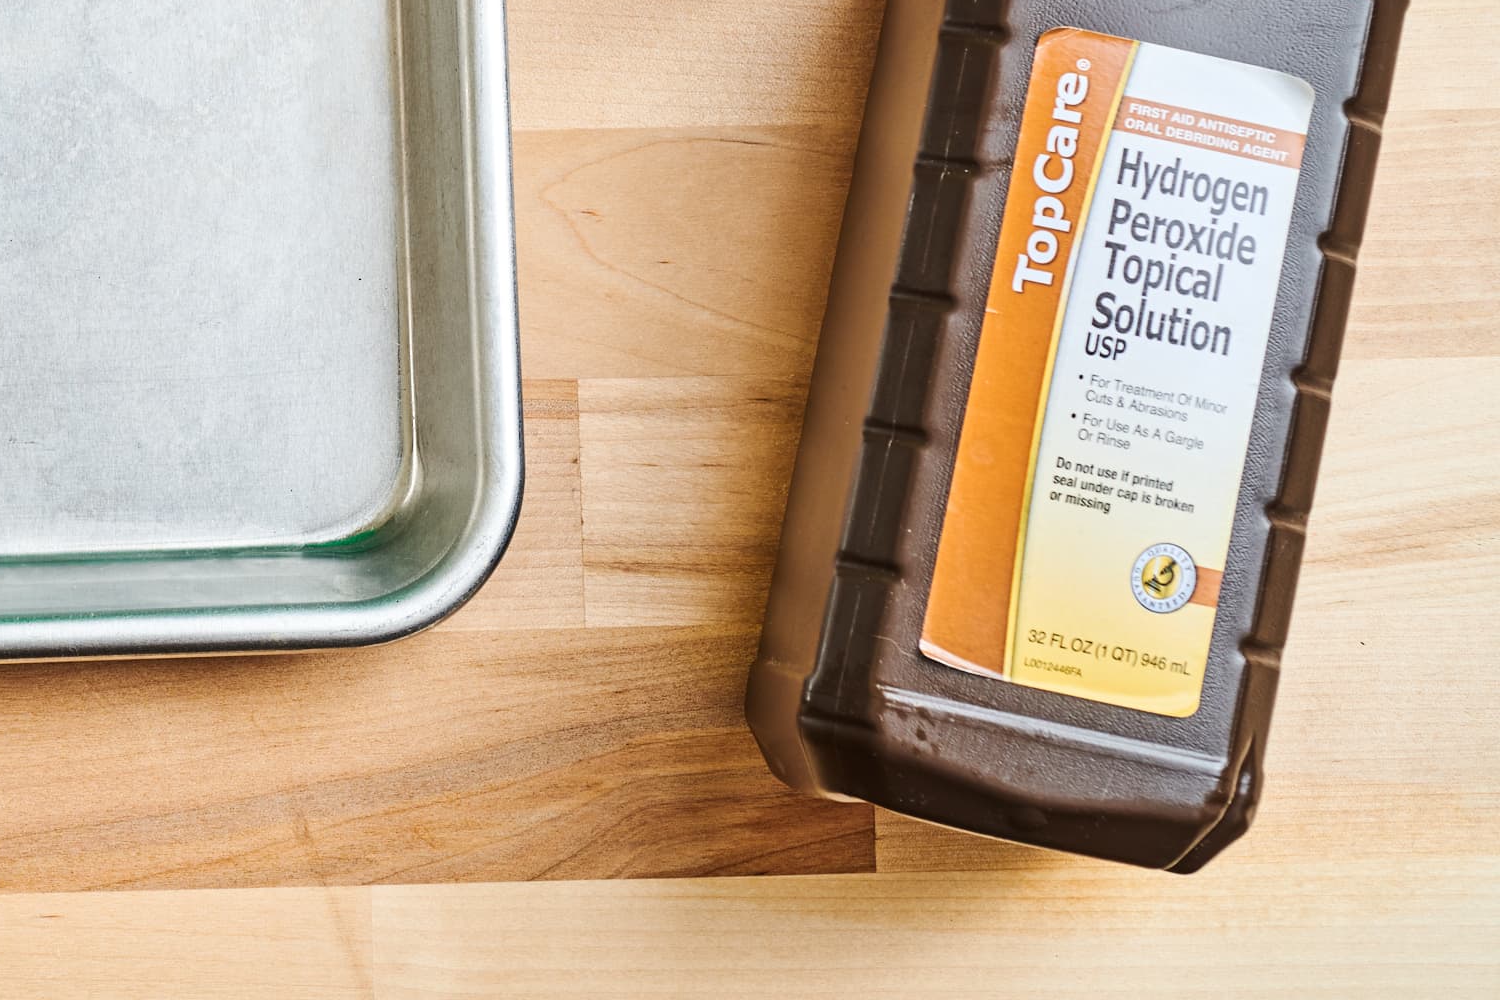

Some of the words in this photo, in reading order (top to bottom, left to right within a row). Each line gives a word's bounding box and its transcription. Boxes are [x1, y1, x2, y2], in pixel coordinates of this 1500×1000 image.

[1124, 118, 1162, 135] ORAL
[1165, 125, 1239, 151] DEBRIDING
[1242, 144, 1289, 162] AGENT
[1129, 103, 1169, 120] FIRST
[1170, 112, 1195, 126] AID
[1197, 119, 1276, 143] ANTISEPTIC
[1012, 71, 1088, 293] TopCare
[1116, 147, 1269, 216] Hydrogen
[1107, 198, 1257, 266] Peroxide
[1104, 241, 1224, 303] Topical
[1091, 292, 1232, 356] Solution
[1085, 332, 1127, 361] USP
[1085, 389, 1113, 406] Cuts
[1116, 396, 1124, 408] &
[1129, 399, 1188, 422] Abrasions
[1090, 374, 1110, 388] For
[1114, 379, 1174, 402] Treatment
[1177, 393, 1193, 406] Of
[1195, 396, 1228, 414] Minor
[1077, 428, 1093, 442] Or
[1096, 432, 1131, 450] Rinse
[1082, 413, 1102, 427] For
[1106, 418, 1130, 433] Use
[1133, 424, 1149, 438] As
[1152, 428, 1161, 441] A
[1165, 430, 1204, 450] Gargle
[1053, 474, 1077, 488] seal
[1080, 480, 1114, 496] under
[1117, 487, 1138, 503] cap
[1142, 492, 1151, 504] is
[1154, 495, 1195, 514] broken
[1056, 456, 1072, 470] Do
[1075, 462, 1094, 475] not
[1097, 467, 1118, 480] use
[1121, 470, 1130, 481] if
[1132, 474, 1174, 492] printed
[1049, 491, 1062, 501] or
[1065, 493, 1111, 514] missing
[1028, 629, 1046, 644] 32
[1050, 633, 1067, 650] FL
[1071, 638, 1093, 654] OZ
[1095, 643, 1107, 660] (1
[1111, 646, 1139, 667] QT)
[1140, 653, 1167, 671] 946
[1170, 660, 1191, 676] mL
